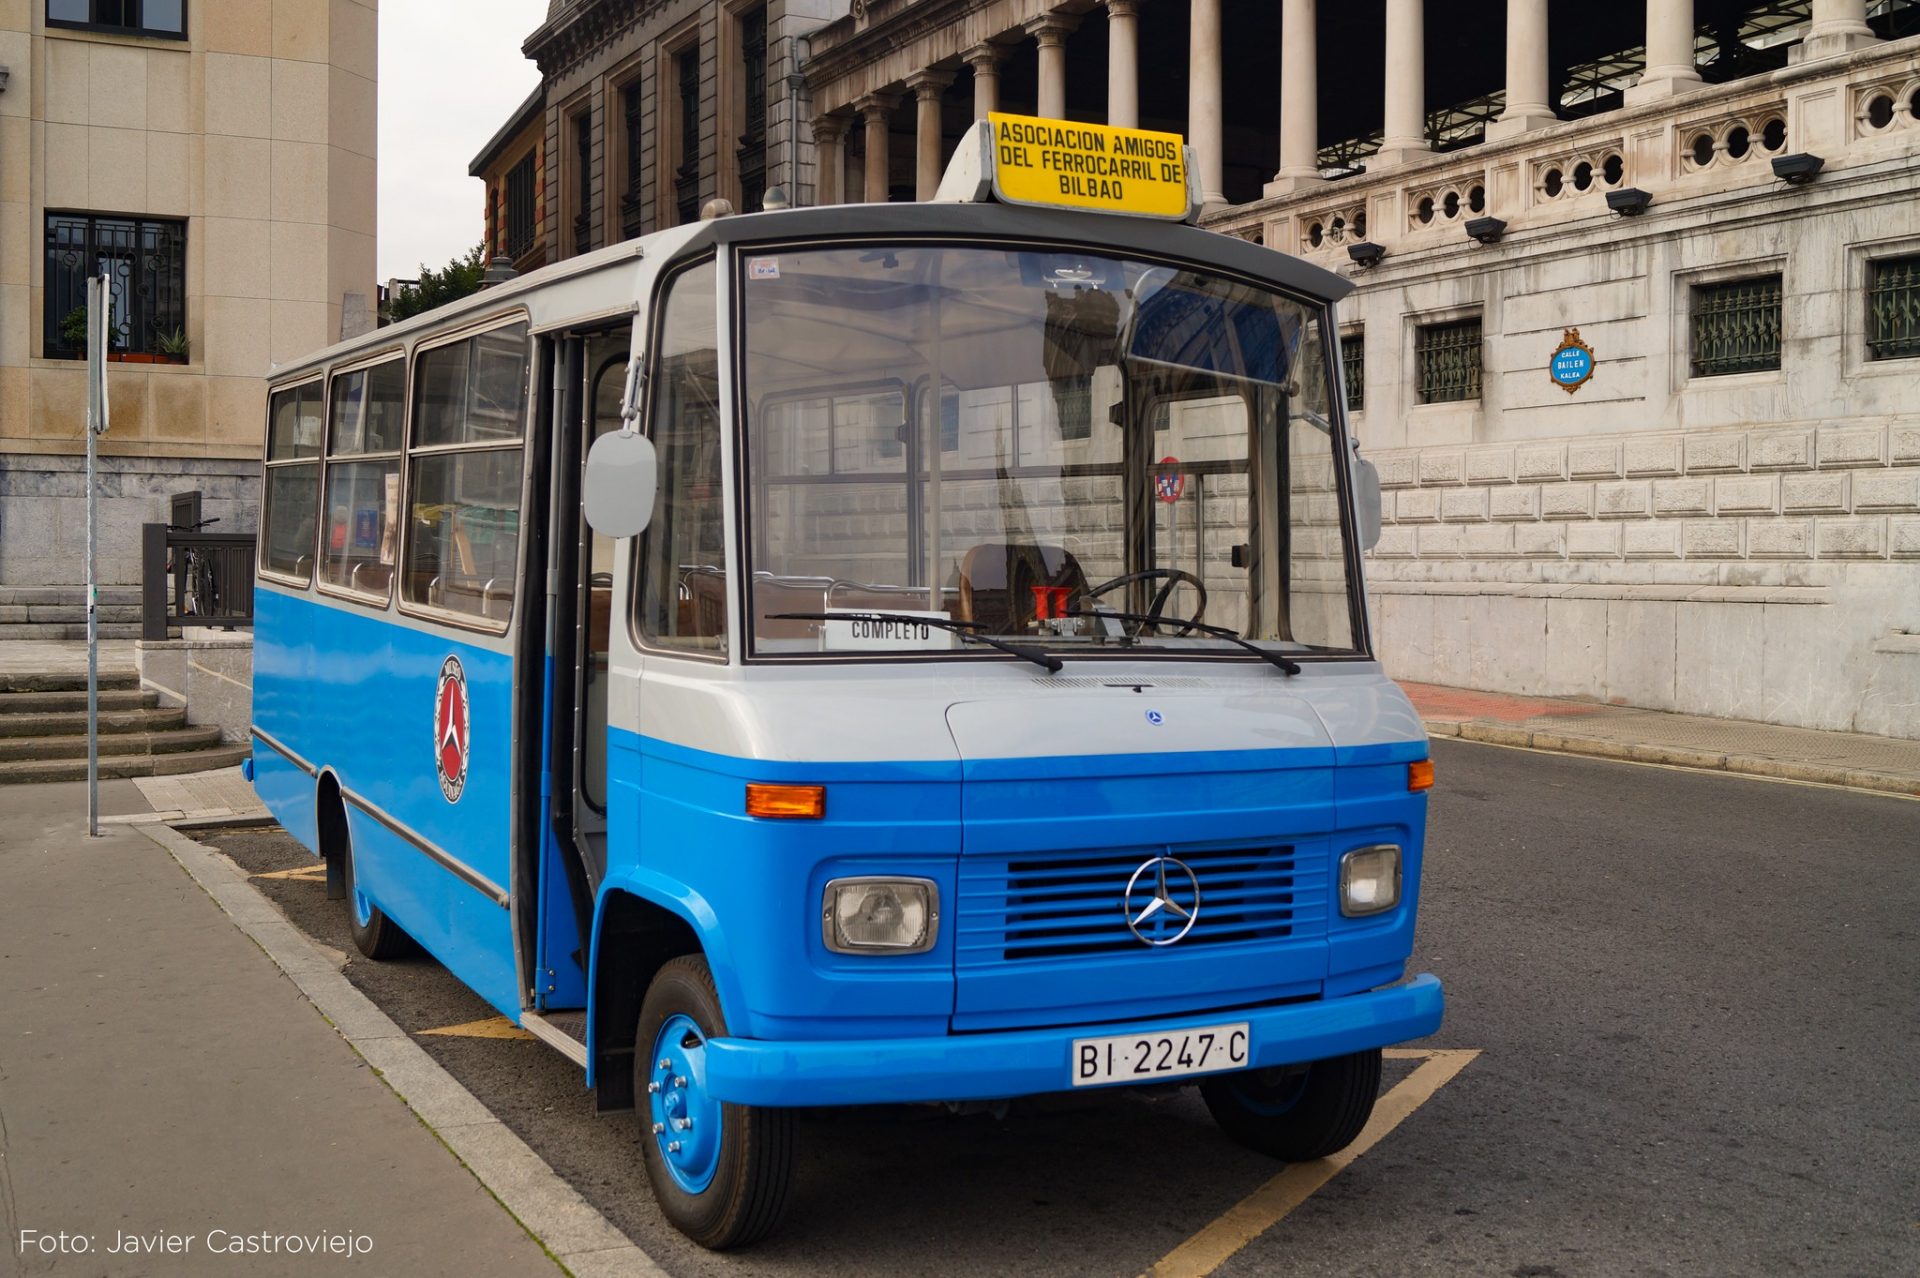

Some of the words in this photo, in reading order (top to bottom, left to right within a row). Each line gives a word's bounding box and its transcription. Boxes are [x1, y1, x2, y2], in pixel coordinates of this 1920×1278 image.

[1000, 121, 1105, 153] ASOCIACION
[1113, 135, 1177, 161] AMIGOS
[1000, 145, 1034, 168] DEL
[1042, 150, 1157, 181] FERROCARRIL
[1161, 163, 1182, 184] DE
[1059, 174, 1124, 200] BILBAO
[1561, 350, 1580, 358] CALLE
[1557, 359, 1585, 370] BAILEN
[1560, 371, 1581, 379] KALEA
[851, 620, 930, 640] COMPLETO
